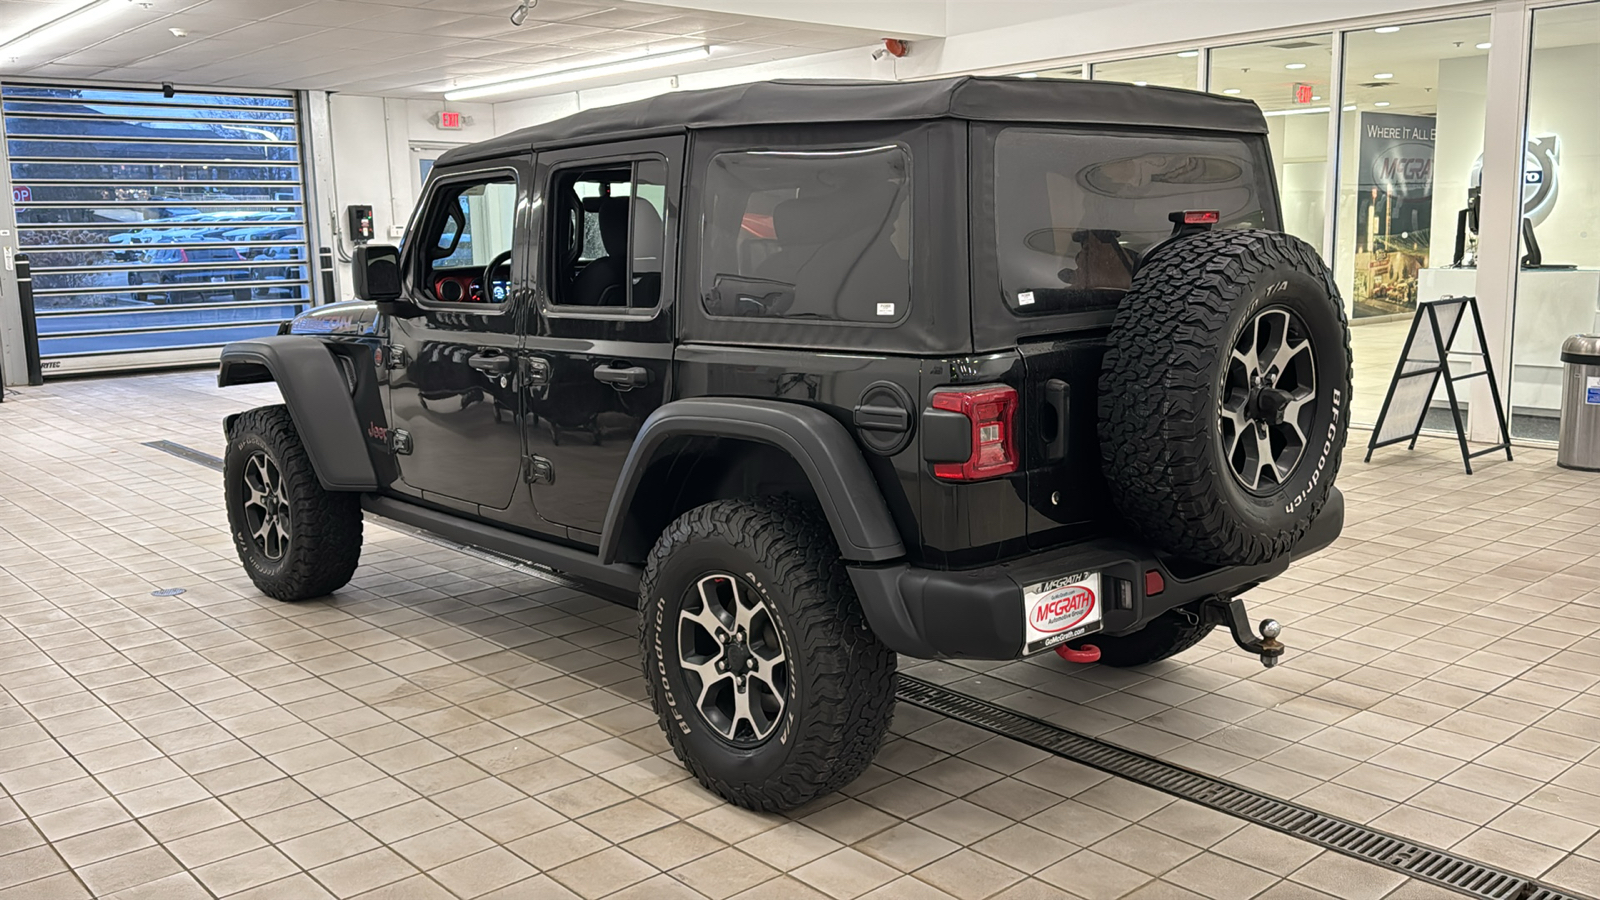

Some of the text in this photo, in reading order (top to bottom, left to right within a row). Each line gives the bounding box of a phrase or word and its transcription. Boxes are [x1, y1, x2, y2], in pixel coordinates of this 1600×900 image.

[1380, 157, 1431, 180] McGRA
[13, 190, 29, 202] OP
[1265, 281, 1288, 297] T/A
[1285, 388, 1341, 514] BFGoodrich
[1036, 592, 1089, 622] McGRATH
[1048, 609, 1084, 625] Automotive Group
[1045, 628, 1085, 646] GoMcGrath.com
[654, 597, 692, 735] BFGoodrich
[780, 712, 795, 745] T/A
